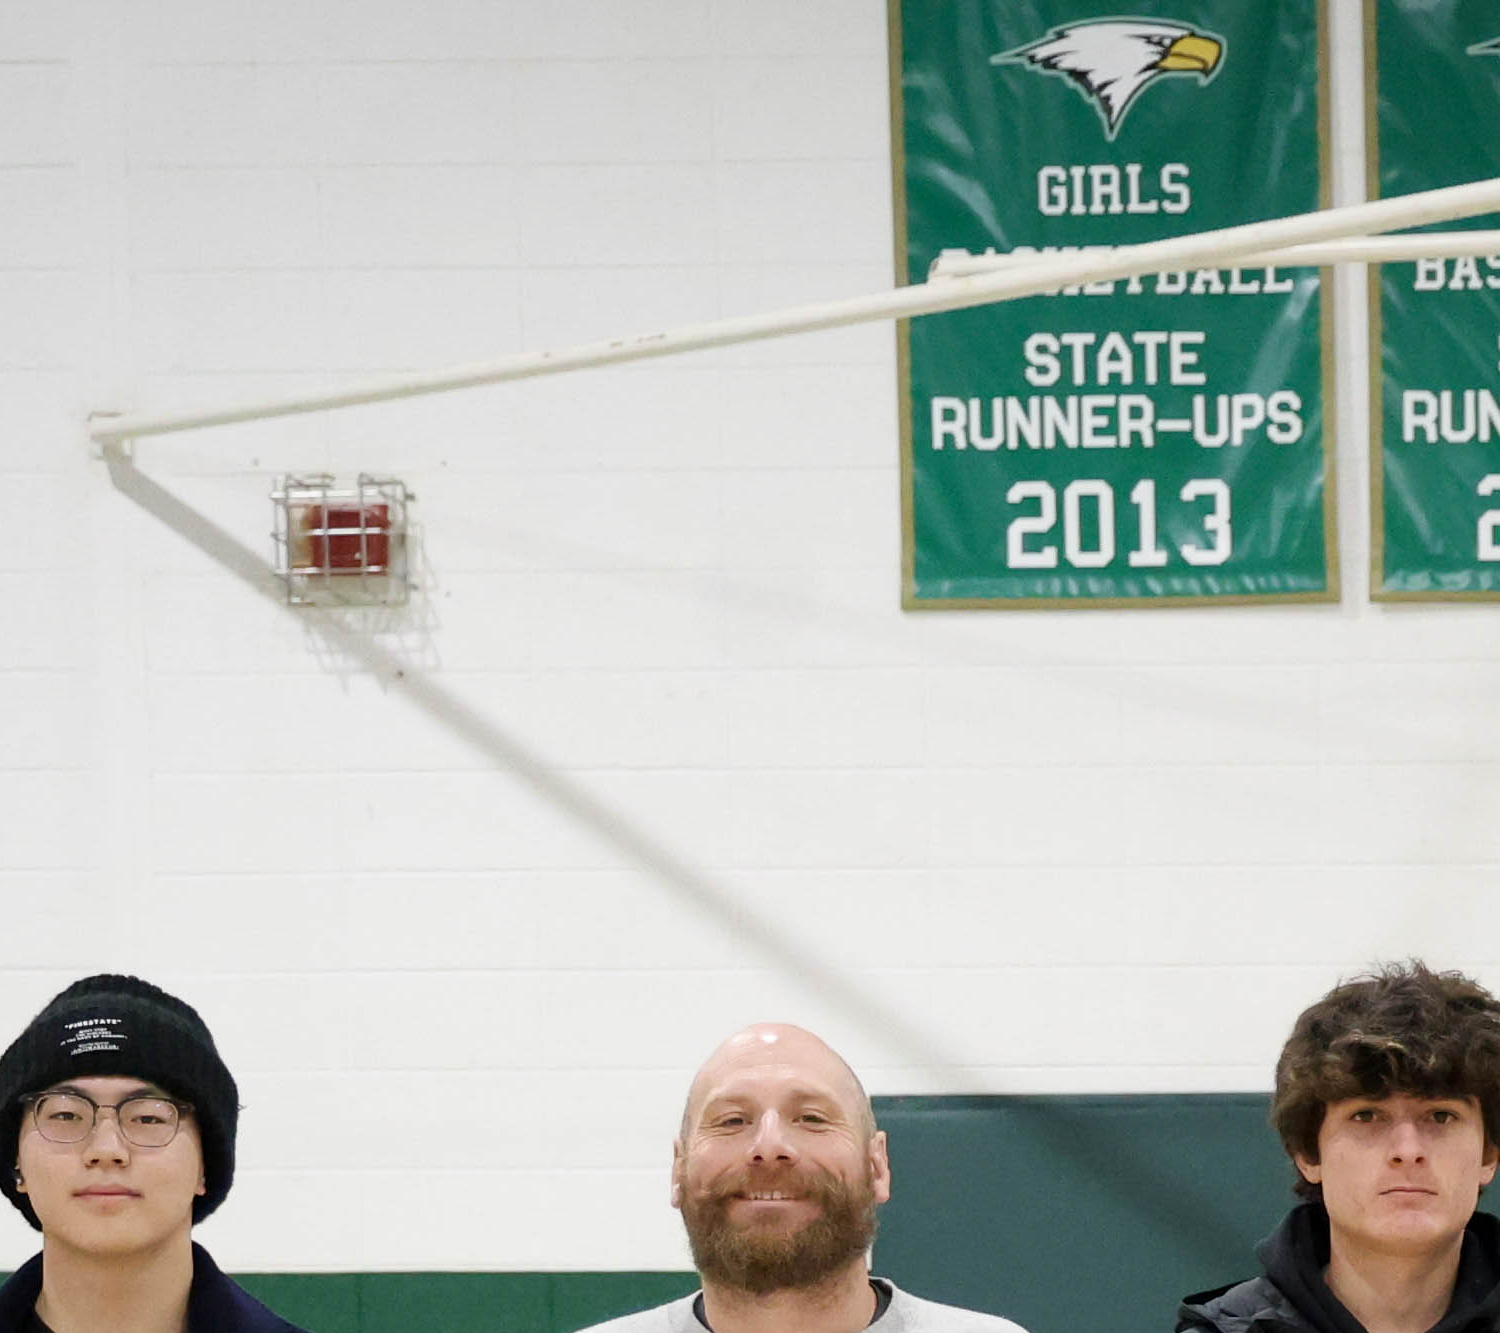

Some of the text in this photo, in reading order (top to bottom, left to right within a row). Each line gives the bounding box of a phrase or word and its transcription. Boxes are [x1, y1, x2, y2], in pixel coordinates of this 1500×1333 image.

[1037, 163, 1192, 216] GIRLS
[1024, 331, 1206, 388] STATE
[931, 390, 1303, 450] RUNNER-UPS
[1006, 477, 1232, 569] 2013
